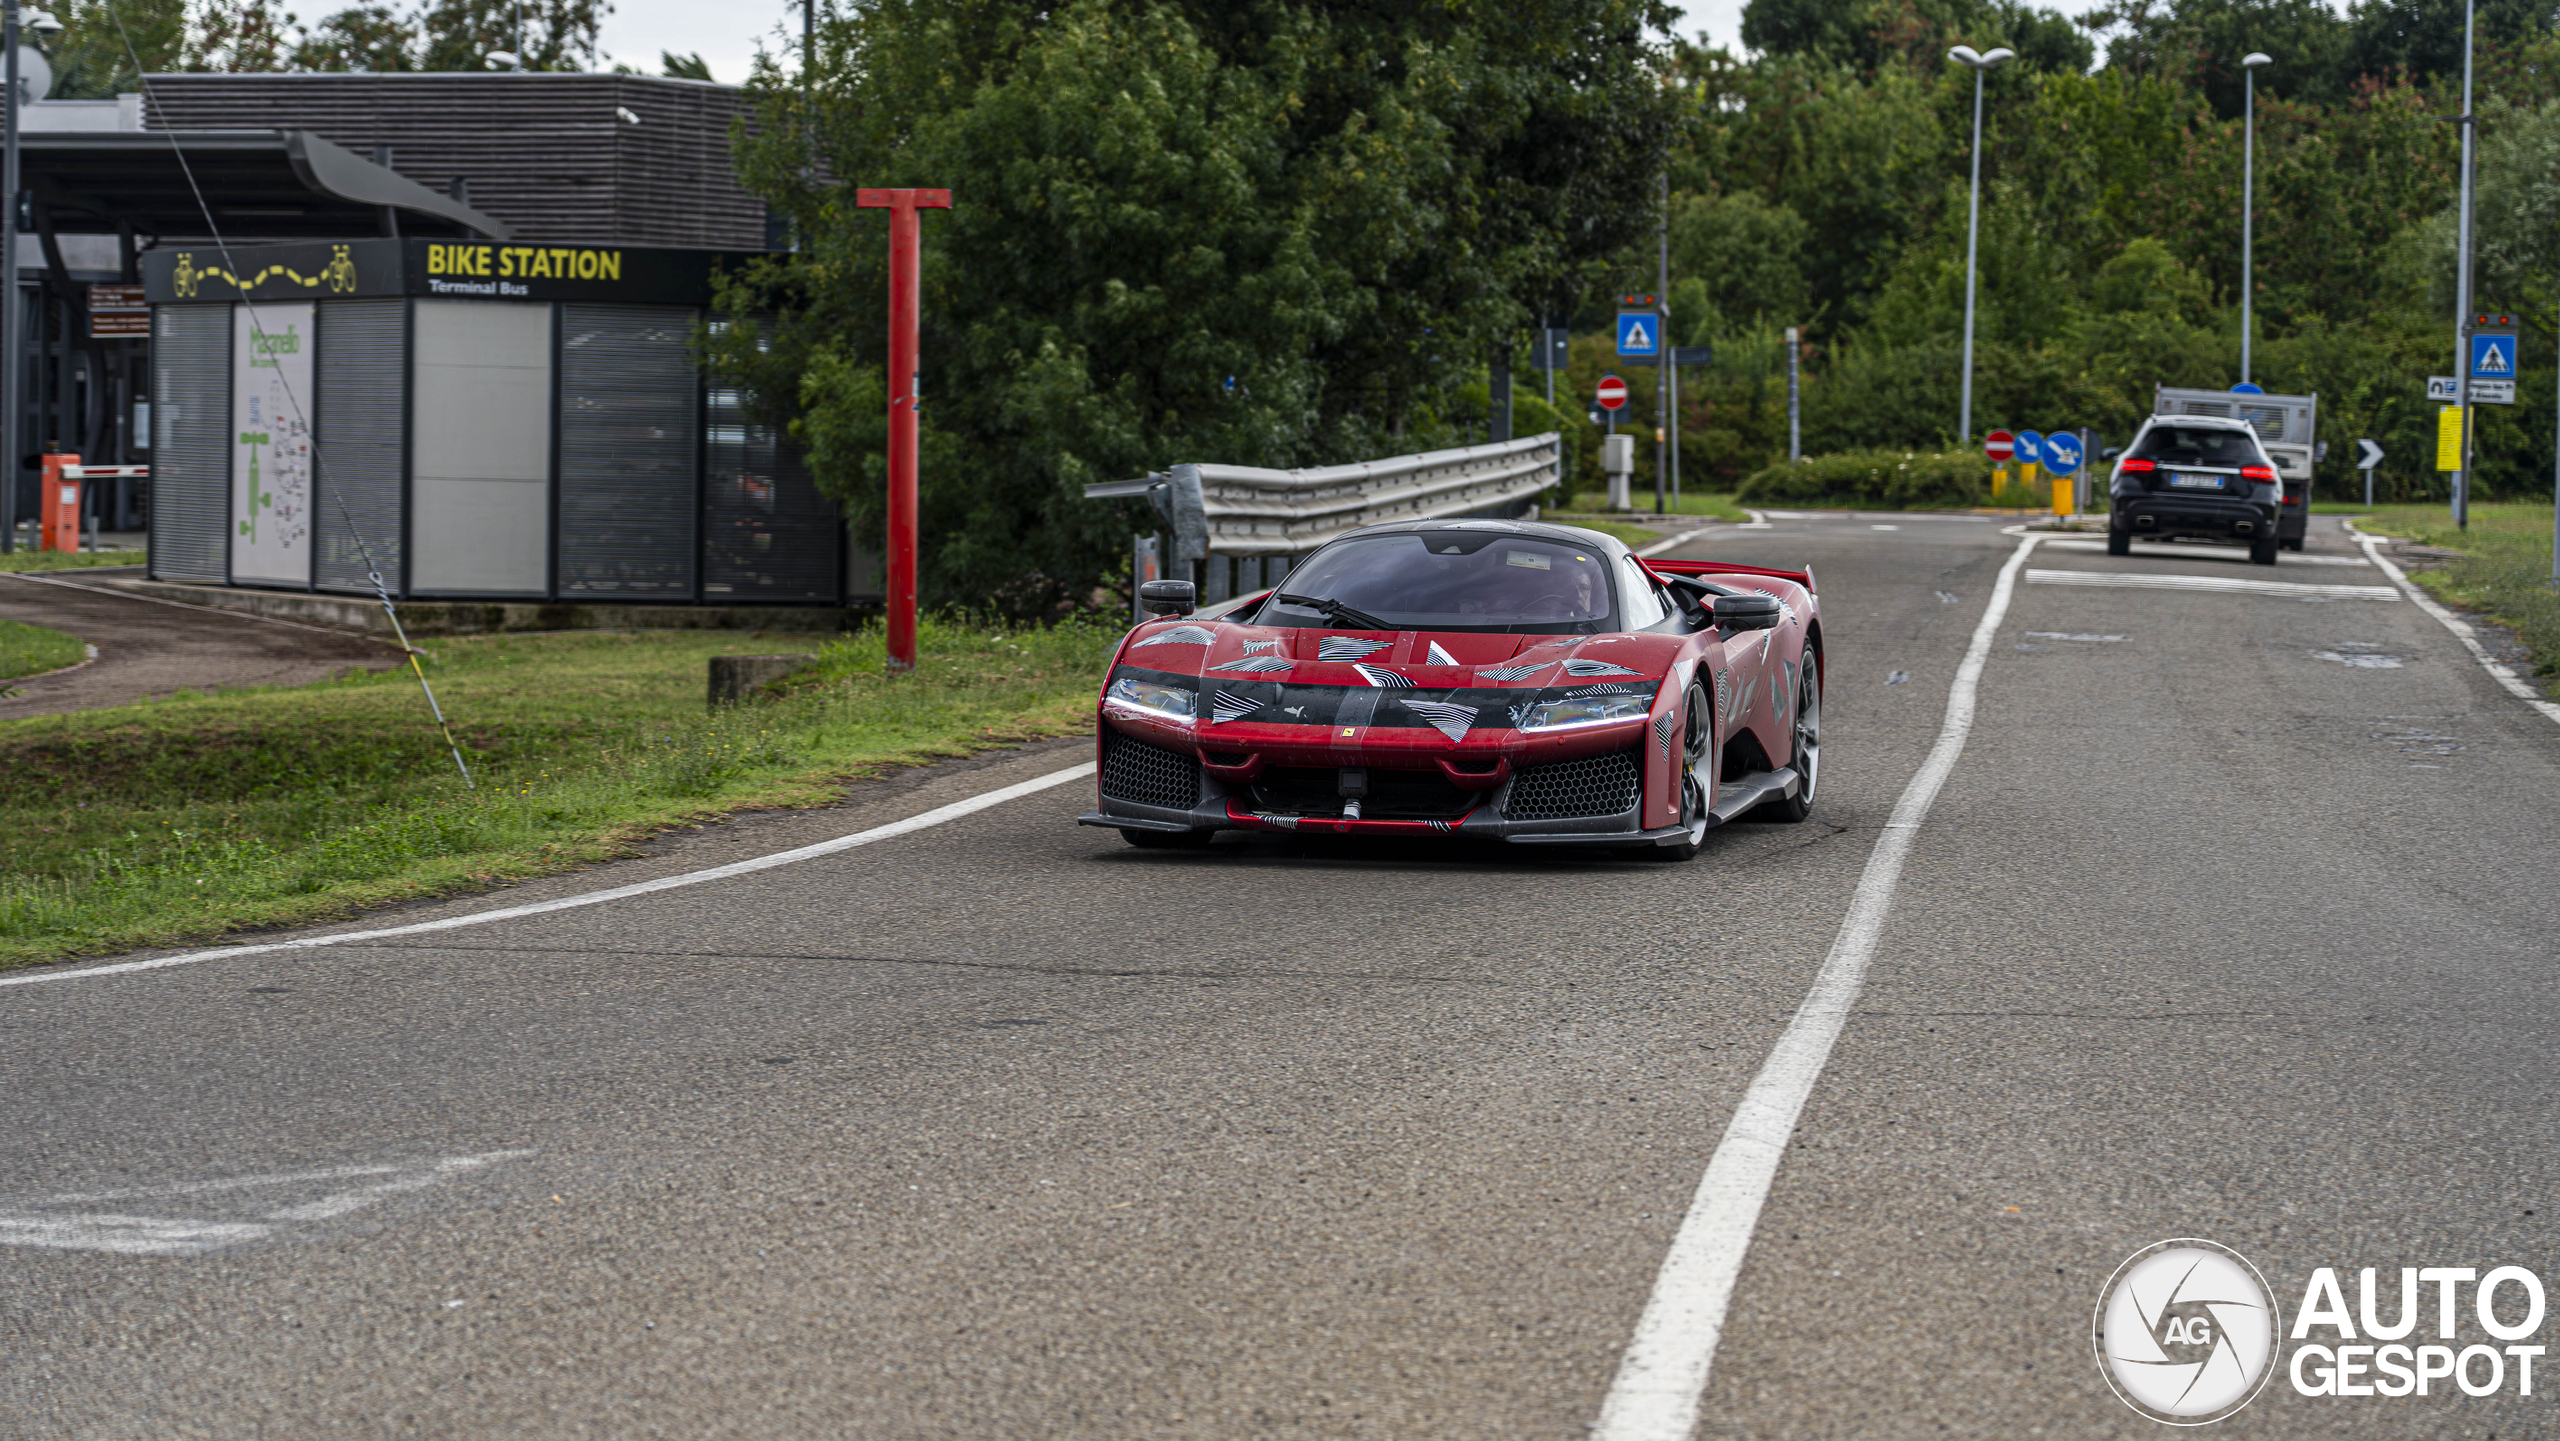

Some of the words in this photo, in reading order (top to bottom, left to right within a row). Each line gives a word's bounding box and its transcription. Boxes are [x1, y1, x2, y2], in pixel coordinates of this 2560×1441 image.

[427, 244, 493, 275] BIKE
[498, 247, 621, 280] STATION
[428, 279, 496, 295] Terminal
[499, 281, 529, 296] Bus
